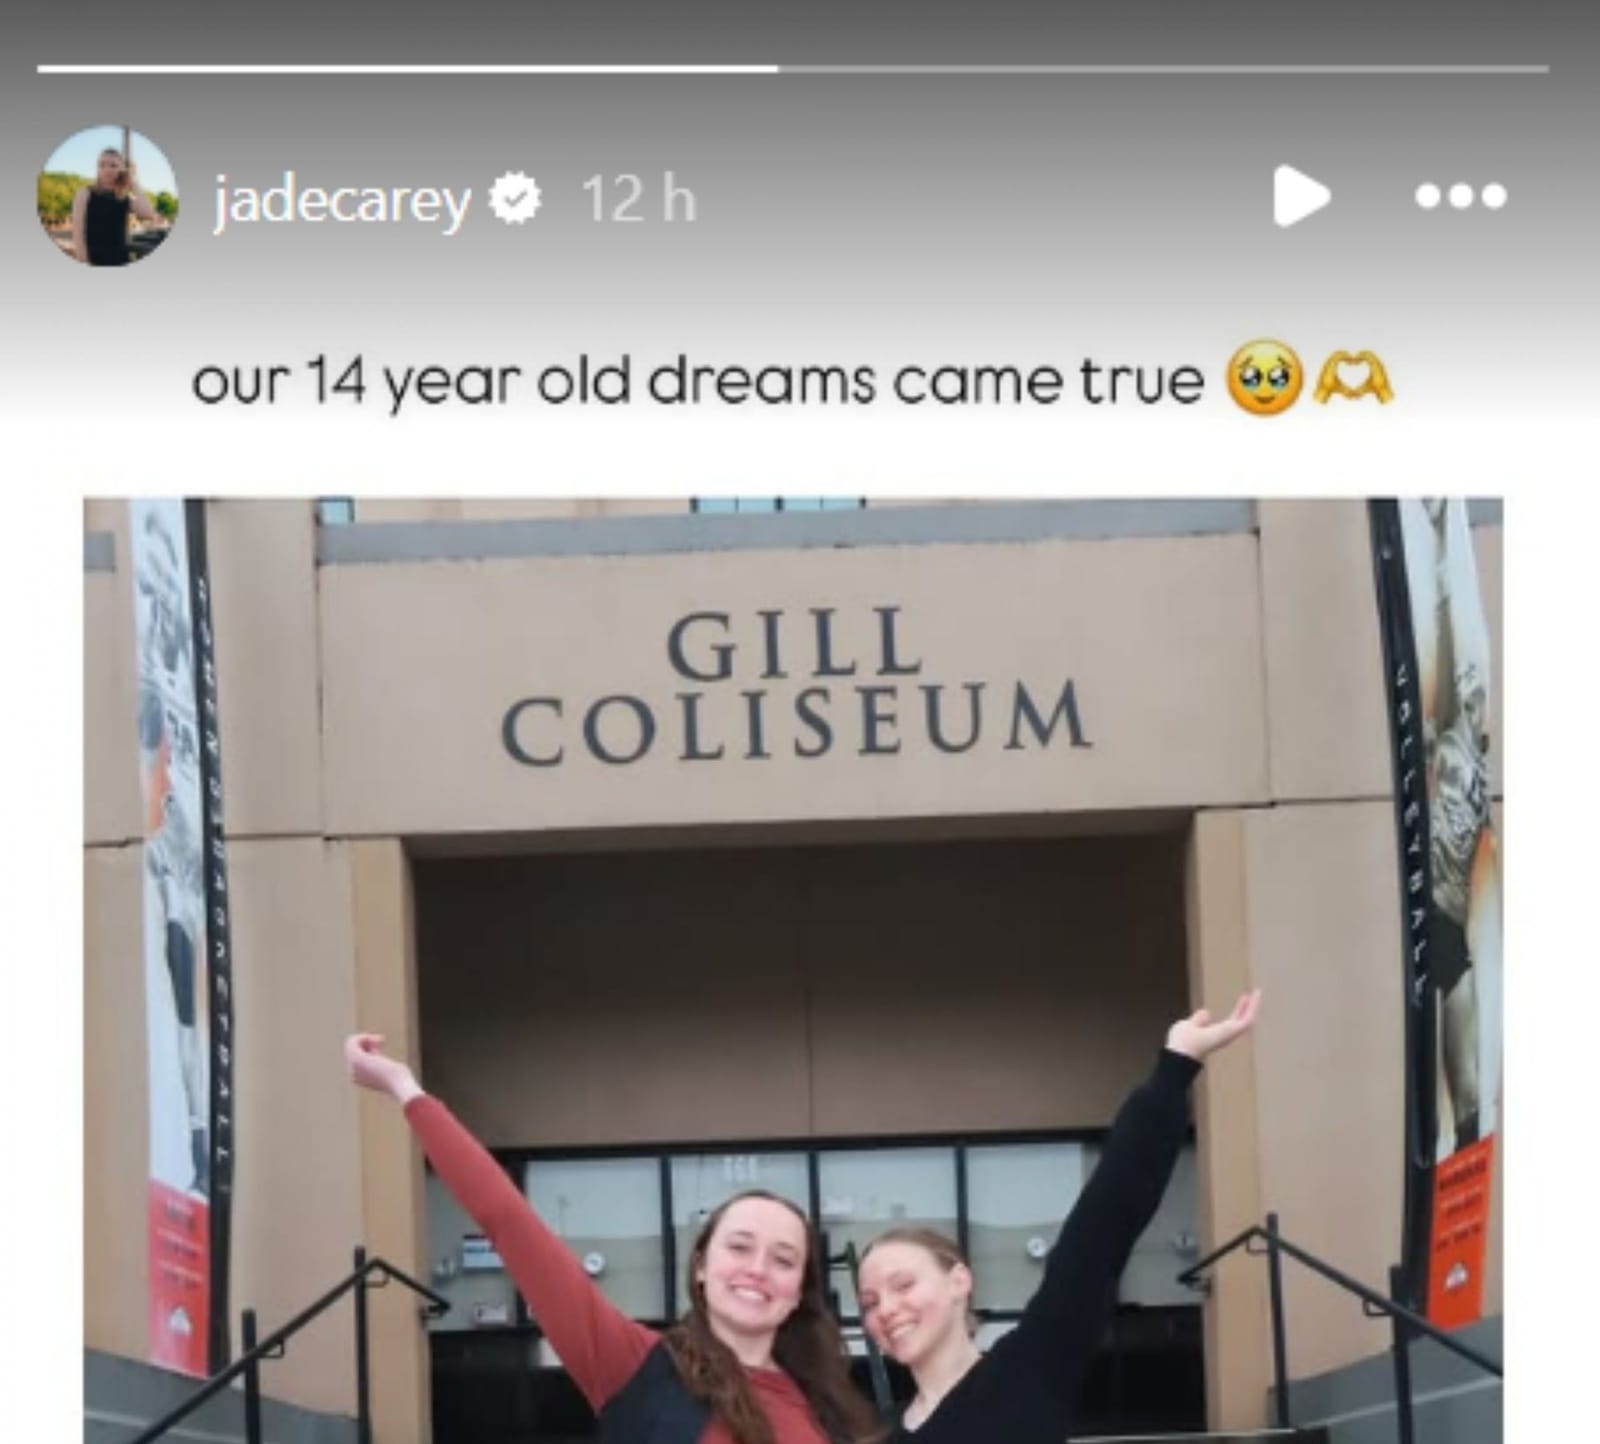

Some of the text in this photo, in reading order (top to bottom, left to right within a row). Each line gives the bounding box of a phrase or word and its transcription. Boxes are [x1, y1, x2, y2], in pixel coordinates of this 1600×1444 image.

[667, 606, 923, 682] GILL
[501, 678, 1093, 767] COLISEUM
[1396, 662, 1428, 998] VOLLEYBALL
